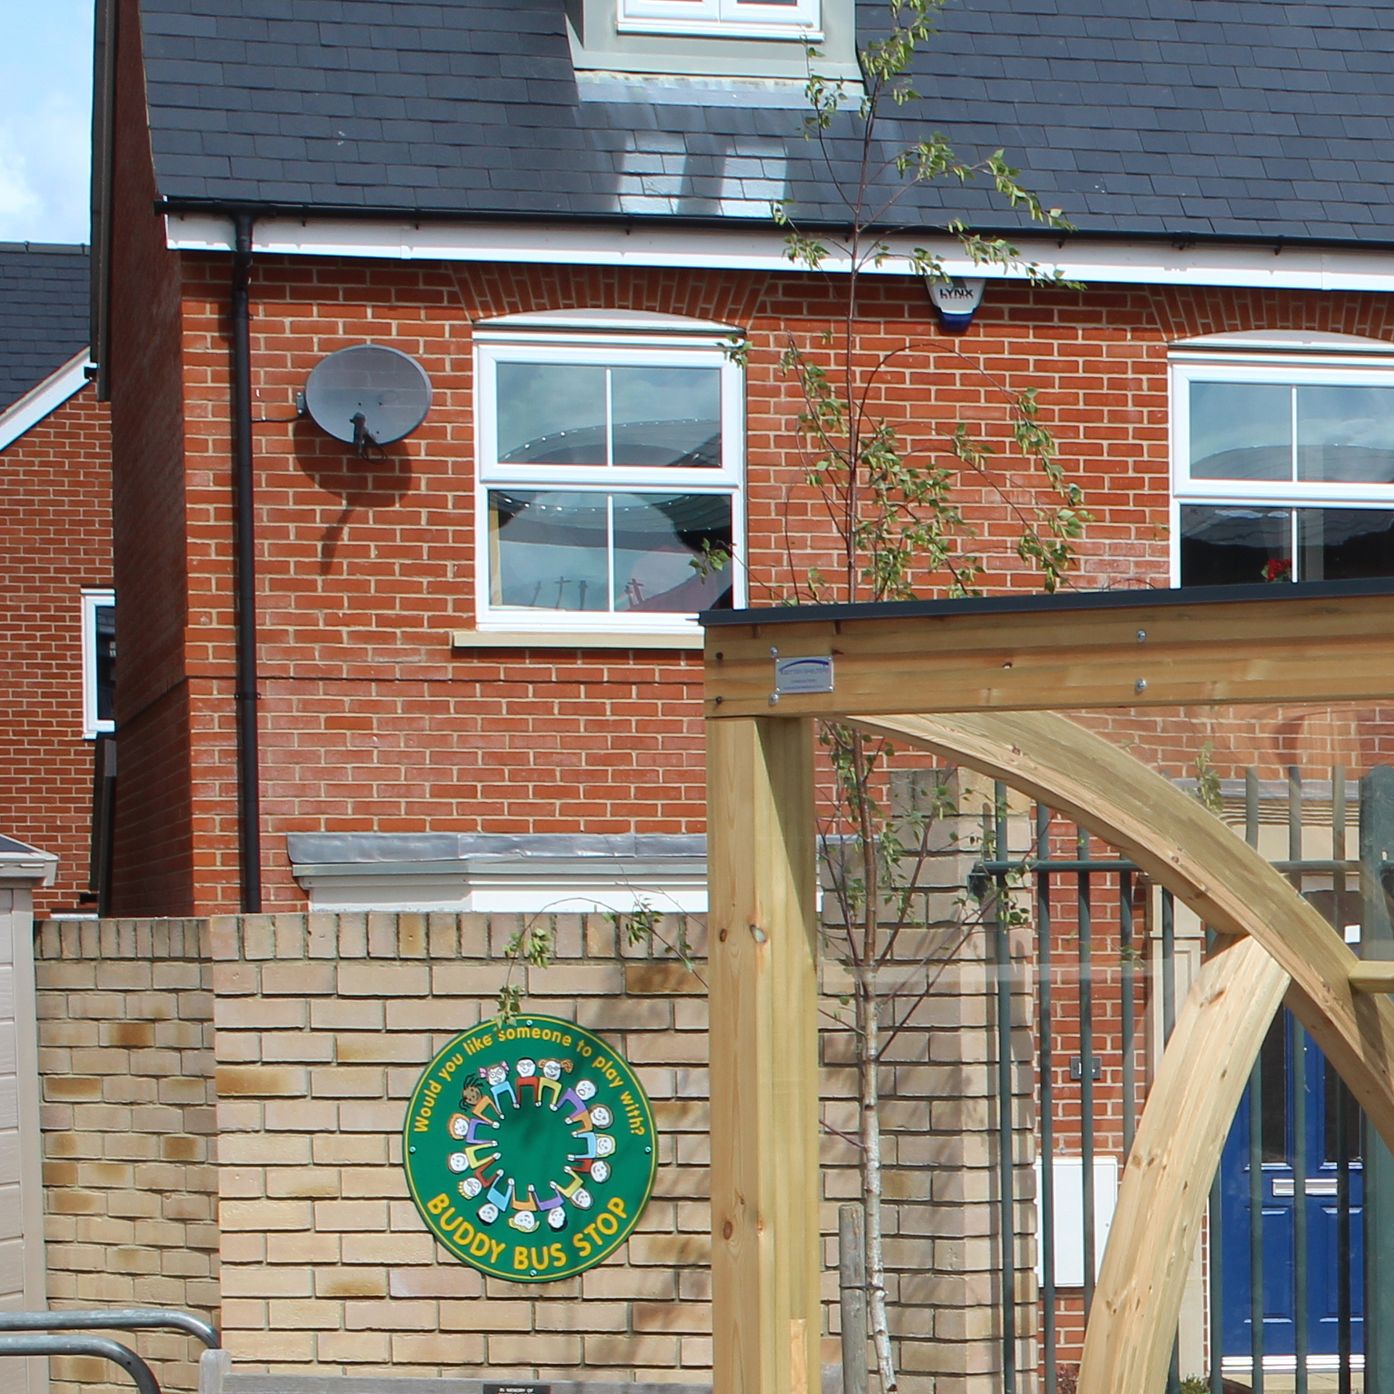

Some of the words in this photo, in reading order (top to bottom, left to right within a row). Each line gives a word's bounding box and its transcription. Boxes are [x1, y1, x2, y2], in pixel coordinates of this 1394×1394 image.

[940, 288, 974, 297] LYNX
[414, 1080, 442, 1132] Would
[439, 1052, 464, 1082] you
[463, 1034, 493, 1056] like
[498, 1027, 572, 1047] someone
[576, 1039, 592, 1057] to
[592, 1056, 624, 1088] play
[620, 1091, 646, 1136] with?
[427, 1193, 506, 1263] BUDDY
[513, 1243, 567, 1270] BUS
[573, 1197, 628, 1257] STOP
